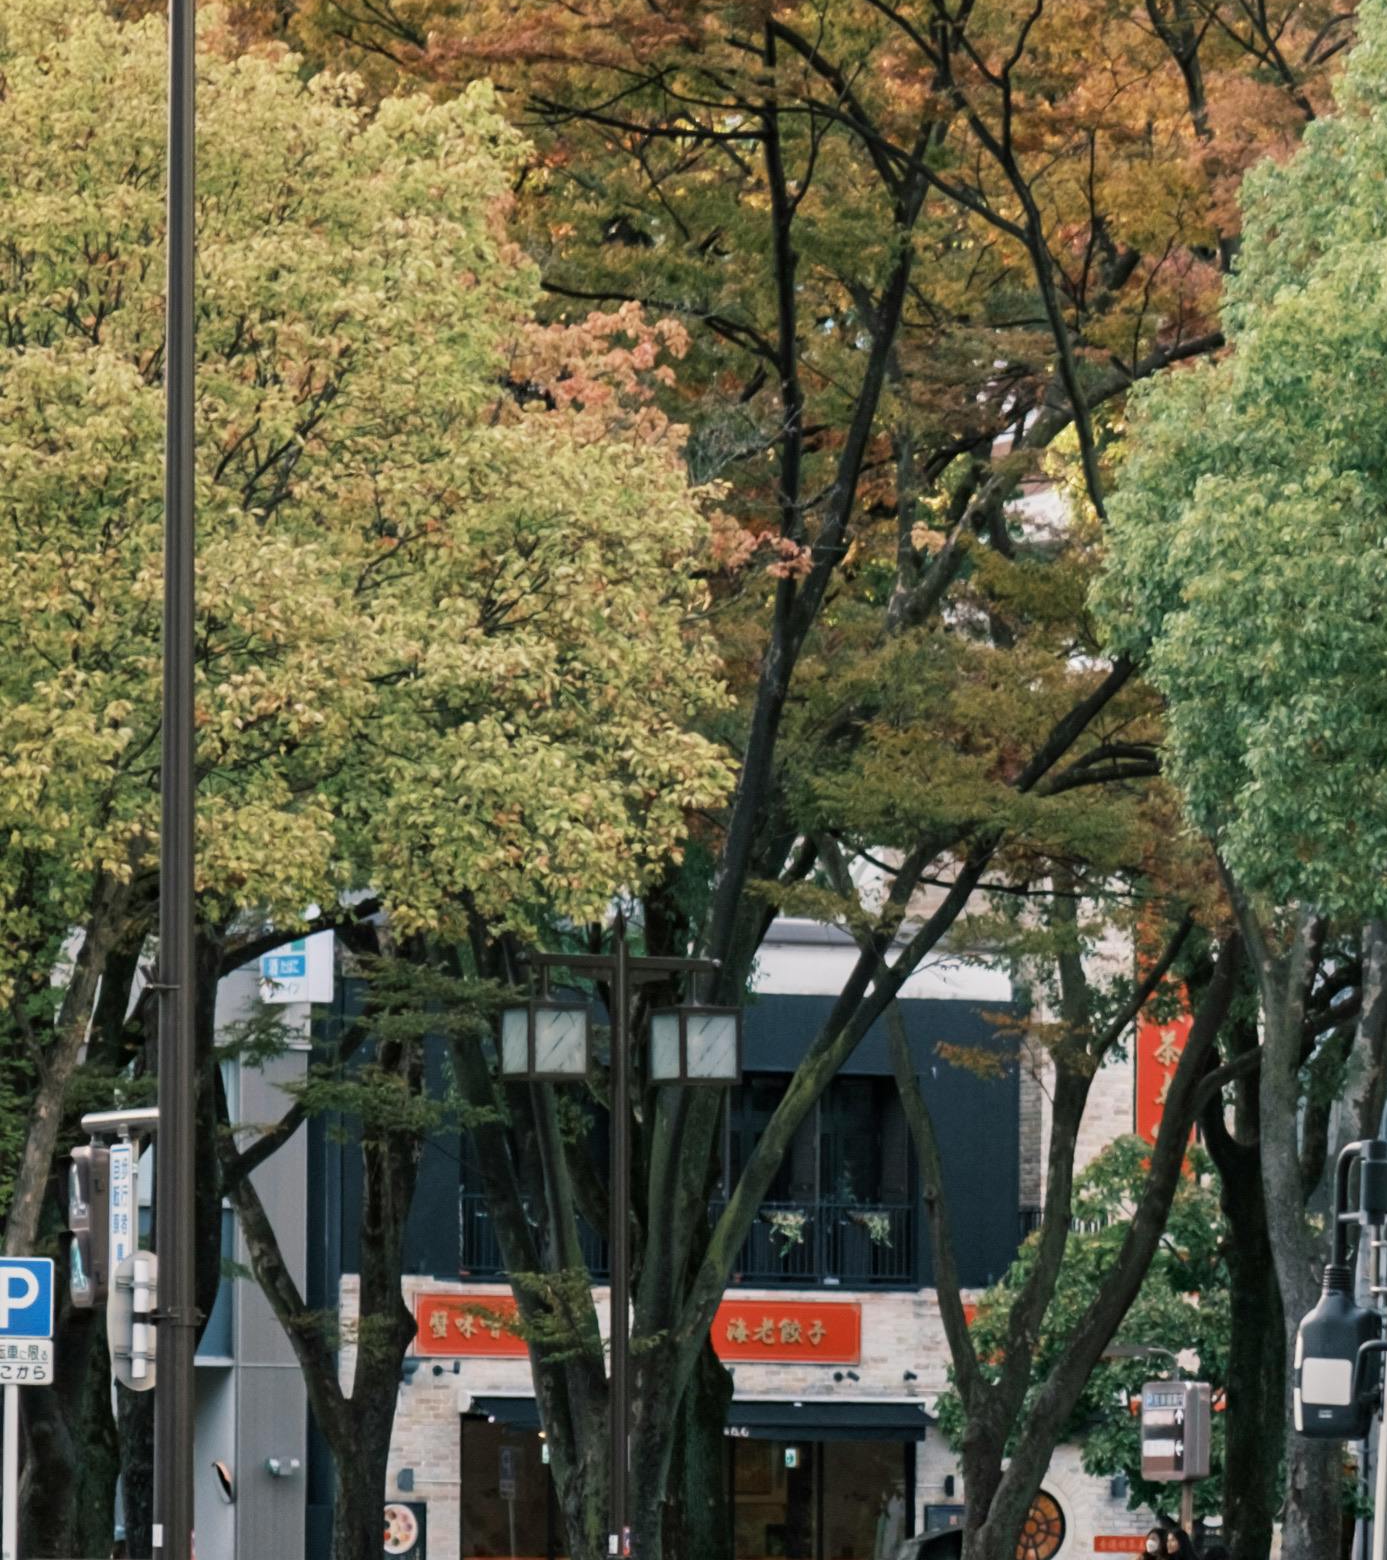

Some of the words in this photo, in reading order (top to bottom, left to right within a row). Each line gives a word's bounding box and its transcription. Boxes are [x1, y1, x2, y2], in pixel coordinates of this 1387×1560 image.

[0, 1266, 40, 1329] P
[726, 1316, 827, 1346] 海老餃子
